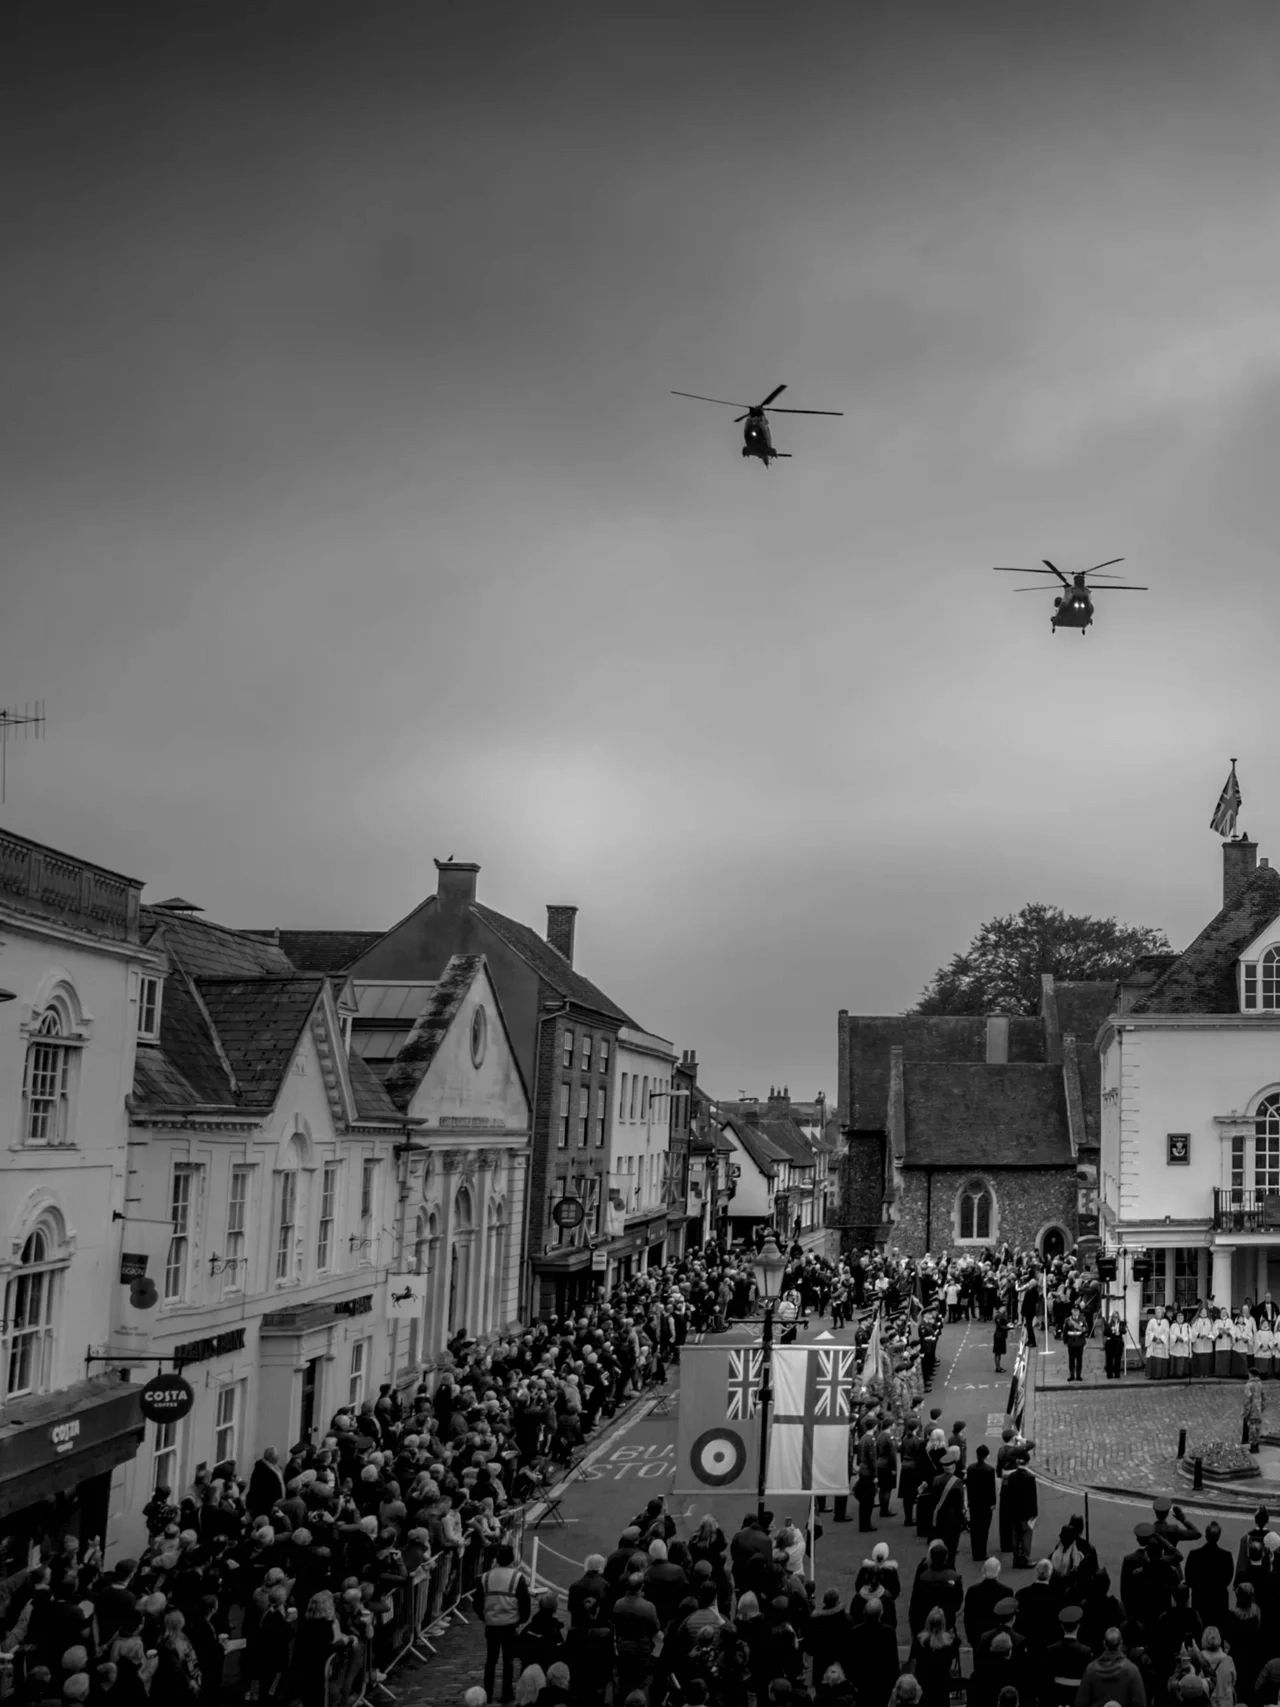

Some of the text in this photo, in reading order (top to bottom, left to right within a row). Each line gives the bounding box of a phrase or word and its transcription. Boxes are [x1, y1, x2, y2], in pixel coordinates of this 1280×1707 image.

[144, 1390, 188, 1402] COSTA
[52, 1419, 81, 1444] COSTA
[609, 1444, 675, 1461] BU
[578, 1461, 677, 1480] STO
